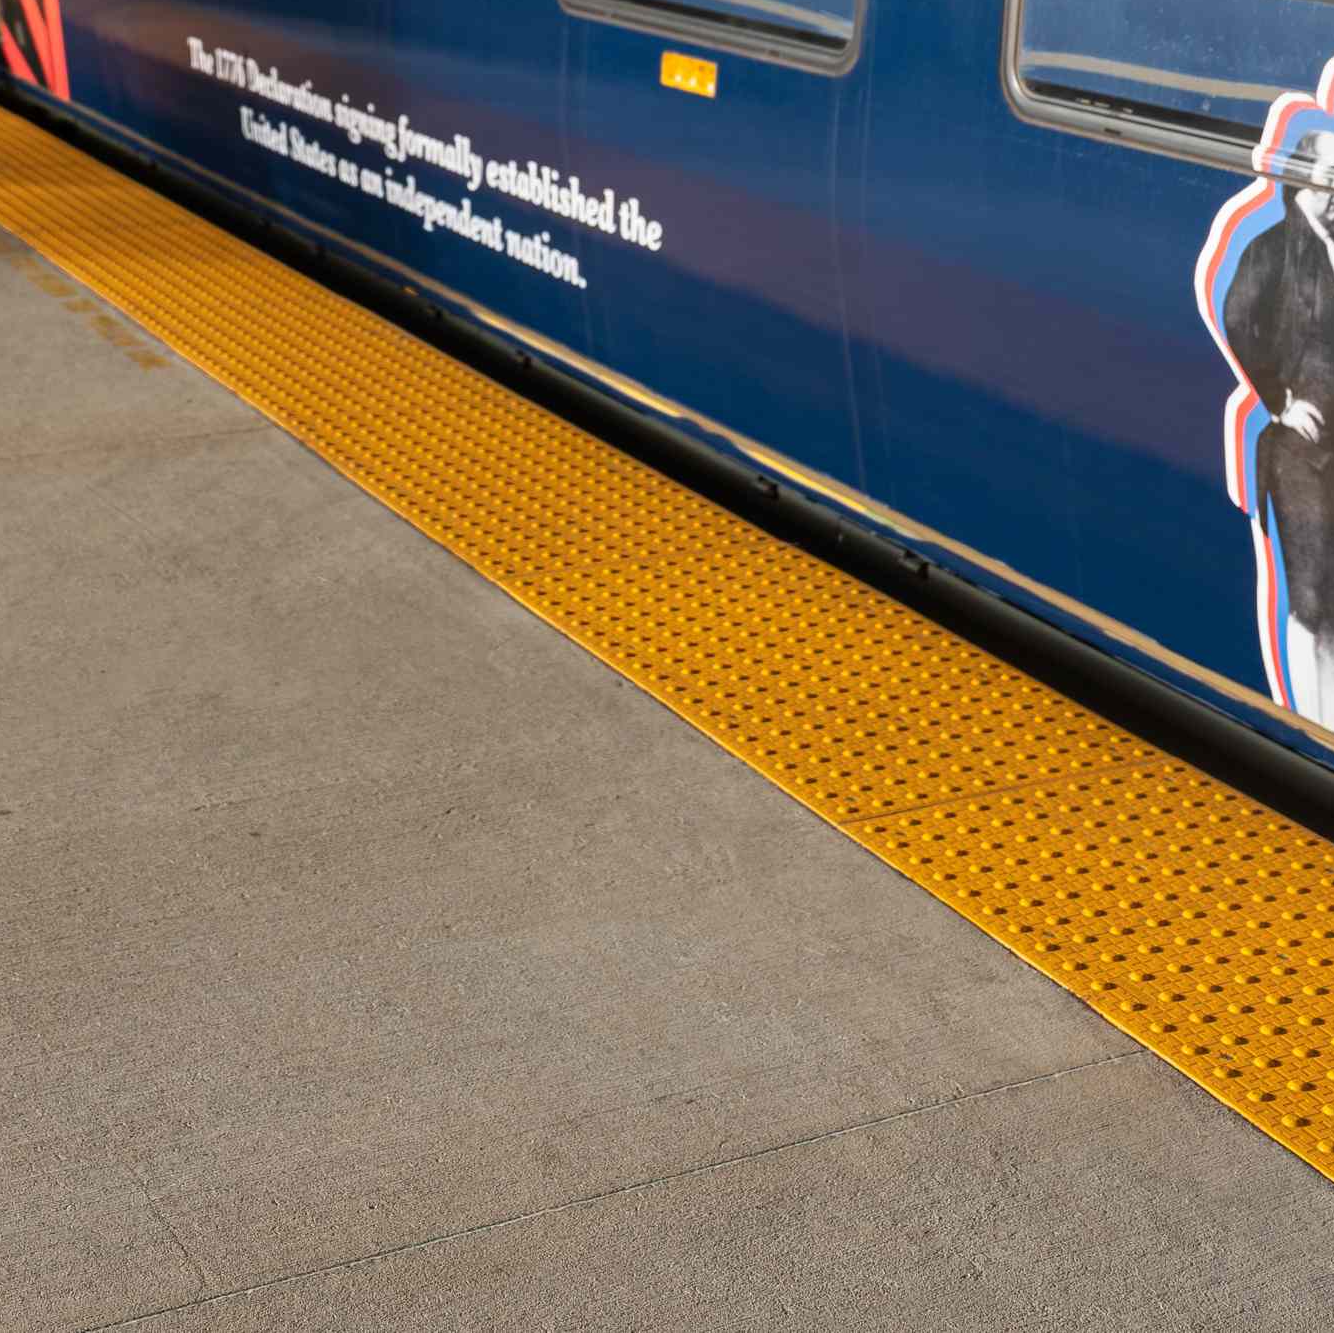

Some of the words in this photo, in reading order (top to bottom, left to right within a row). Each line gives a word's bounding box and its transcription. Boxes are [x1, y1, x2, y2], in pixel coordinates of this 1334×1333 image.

[187, 36, 214, 76] The
[215, 47, 246, 88] 1776
[246, 57, 333, 123] Declaration
[334, 93, 397, 159] signing
[397, 114, 483, 191] formally
[485, 159, 616, 234] established
[618, 197, 663, 251] the
[239, 104, 288, 156] United
[289, 125, 337, 178] States
[338, 158, 358, 188] as
[360, 167, 384, 198] an
[385, 166, 505, 252] independent
[504, 230, 588, 290] nation.
